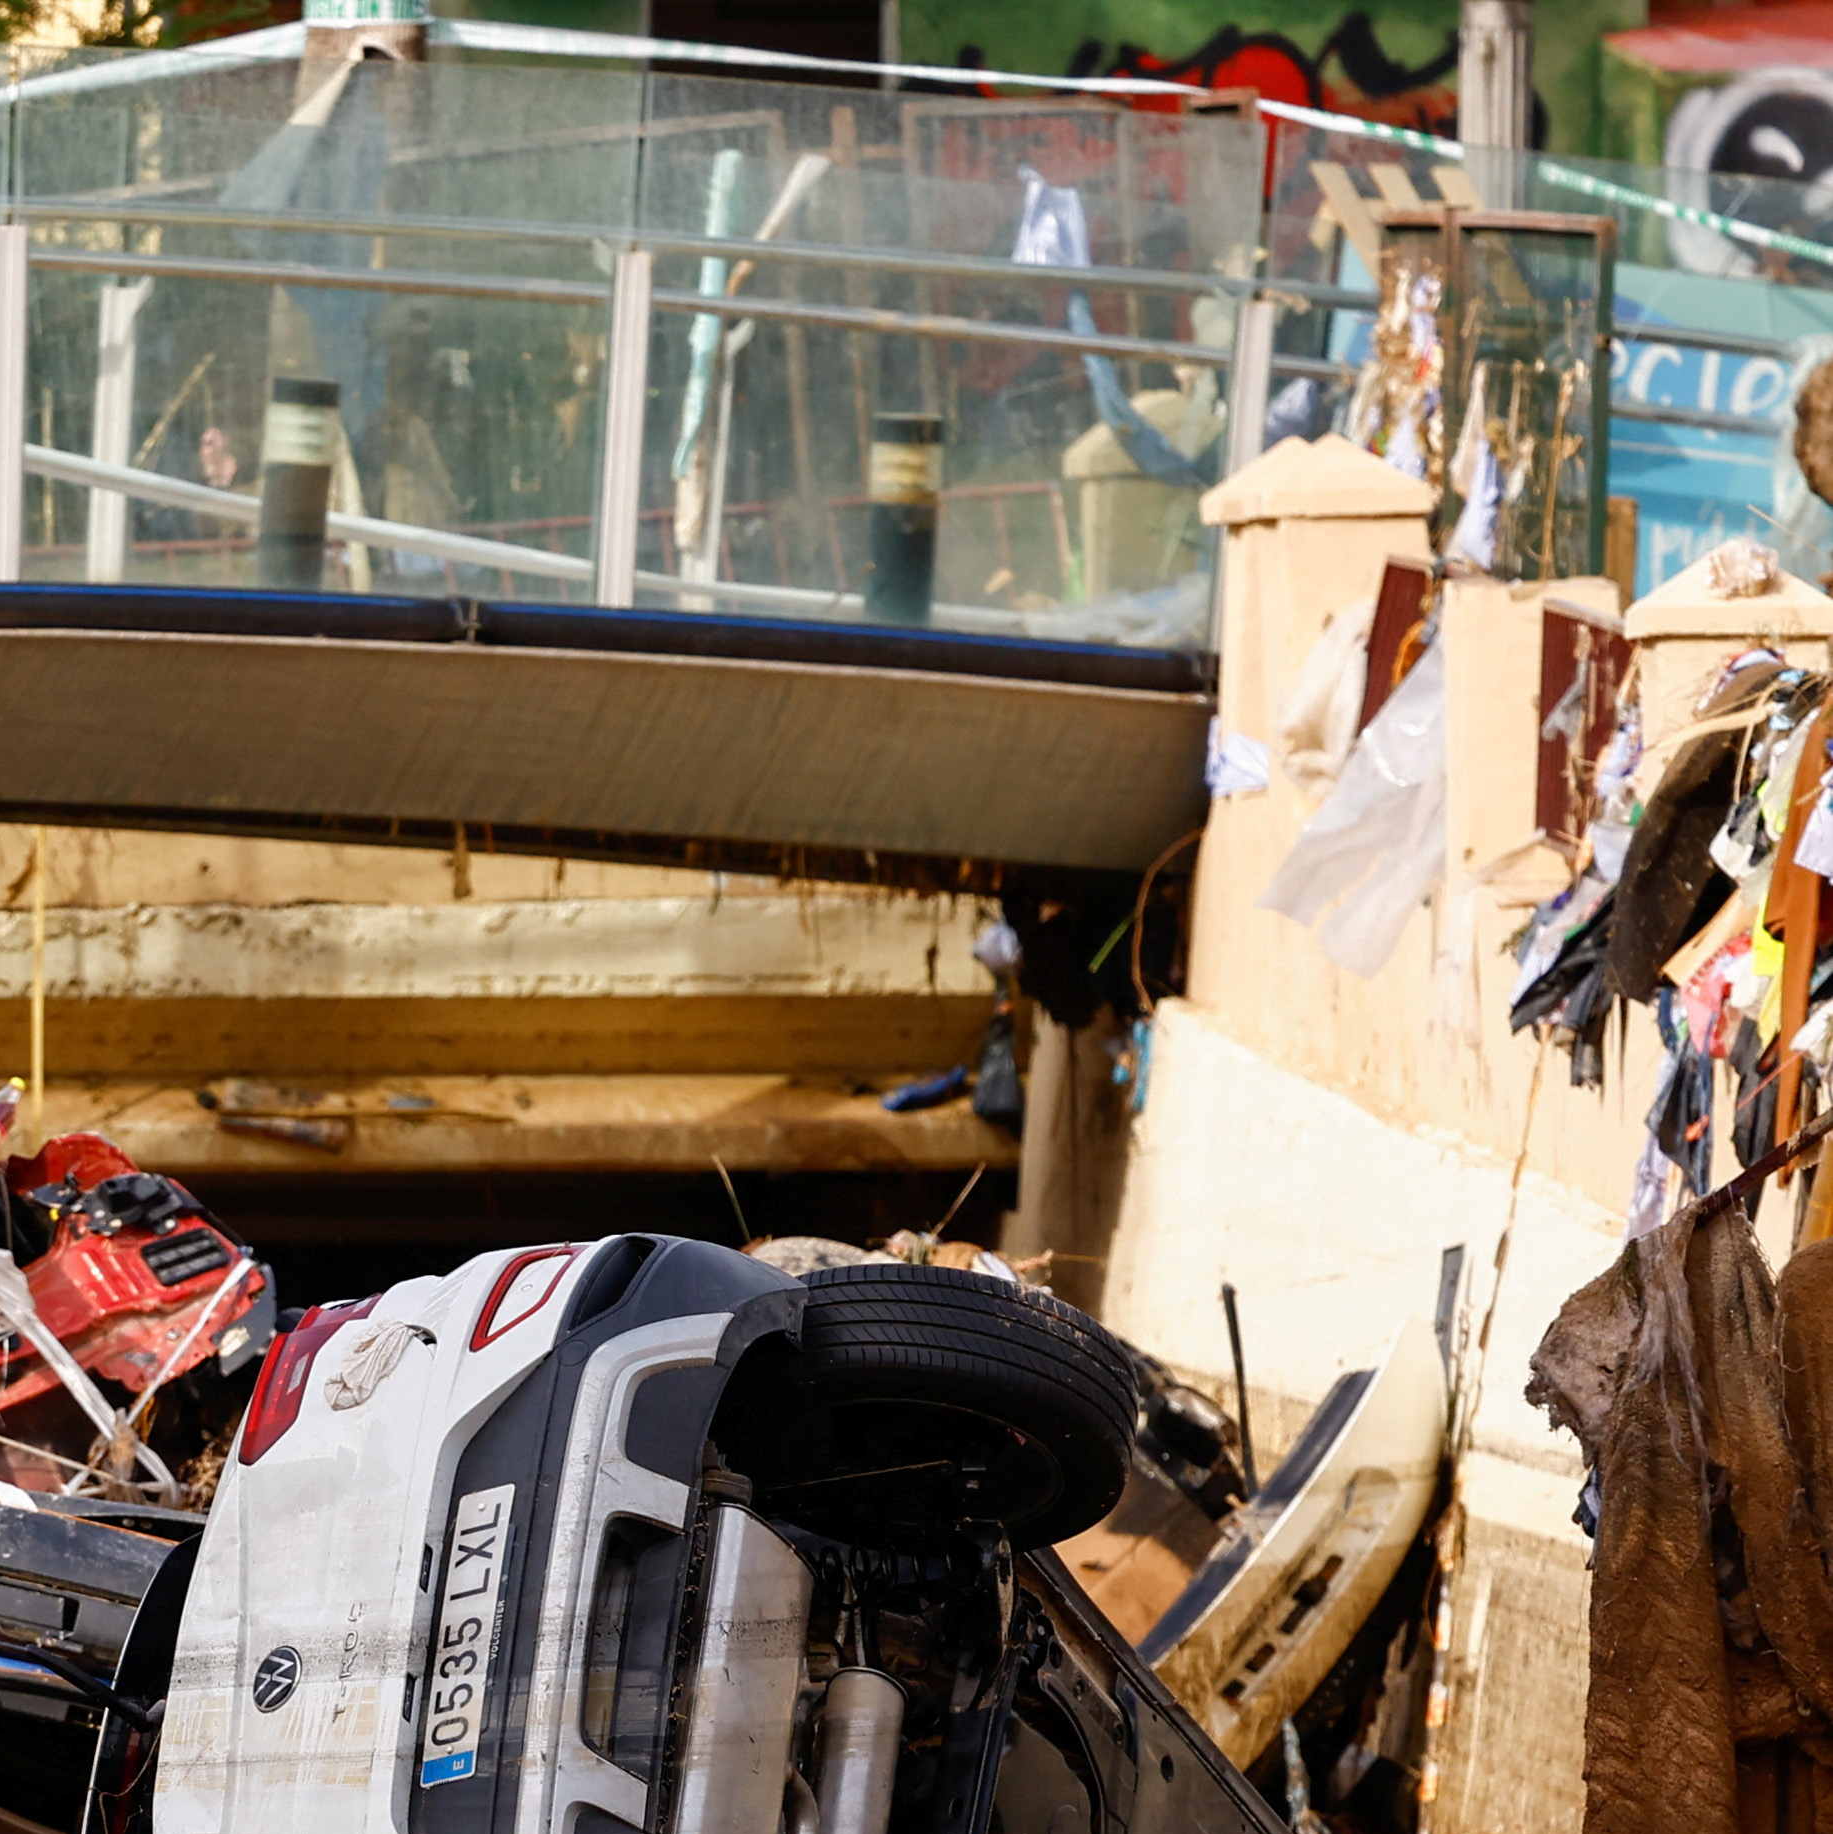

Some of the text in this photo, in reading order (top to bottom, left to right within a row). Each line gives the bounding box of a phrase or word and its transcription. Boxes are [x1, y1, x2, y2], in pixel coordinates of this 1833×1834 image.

[431, 1500, 504, 1749] 0535 LXL
[489, 1598, 507, 1662] VOLCENTER
